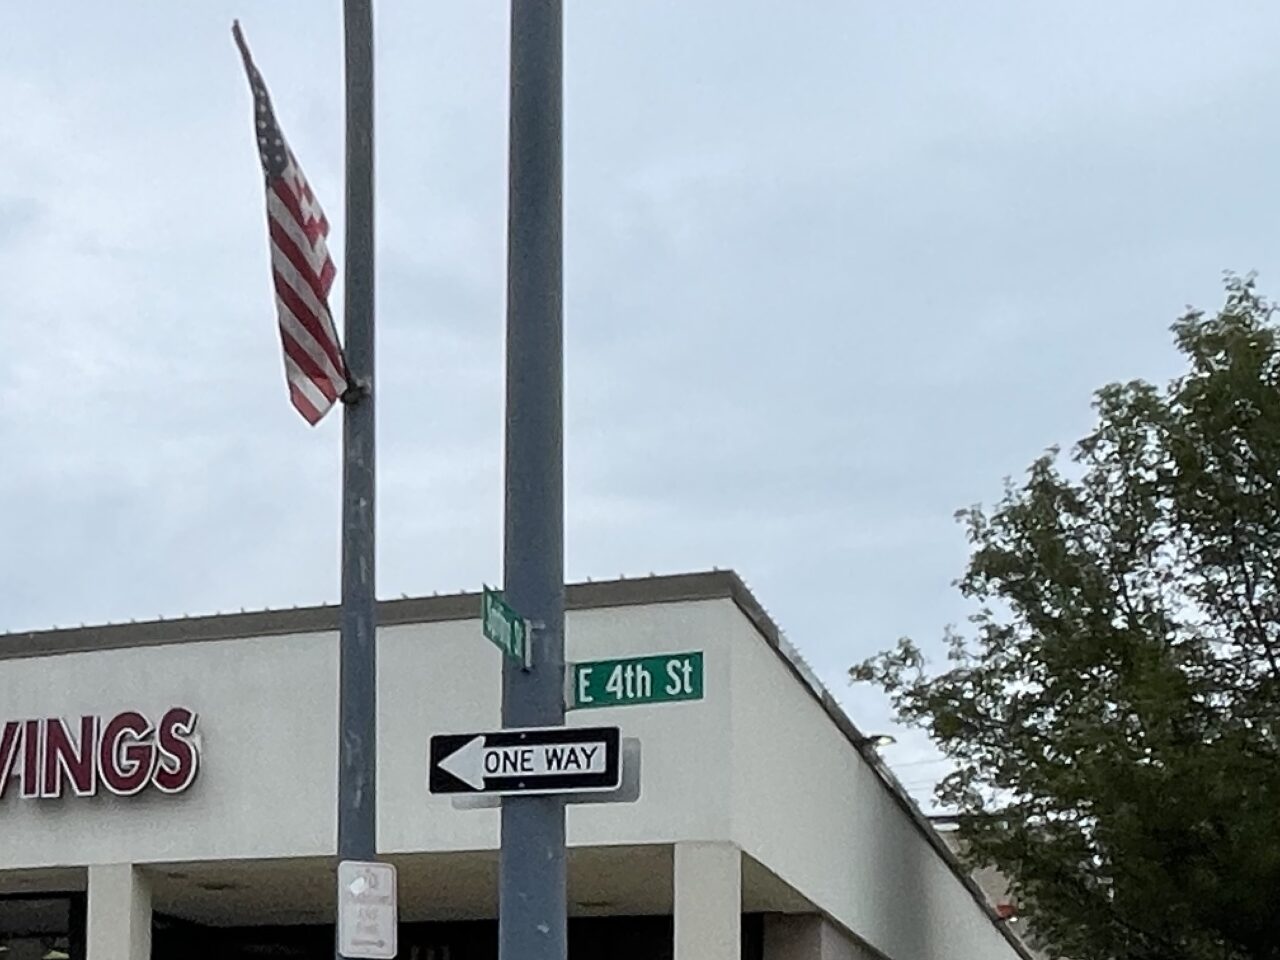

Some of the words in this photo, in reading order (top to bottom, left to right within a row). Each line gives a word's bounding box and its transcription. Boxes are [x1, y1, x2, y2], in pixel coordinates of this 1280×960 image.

[578, 668, 593, 702] E
[605, 664, 652, 700] 4th
[665, 661, 693, 696] St
[484, 749, 534, 773] ONE
[544, 745, 598, 771] WAY
